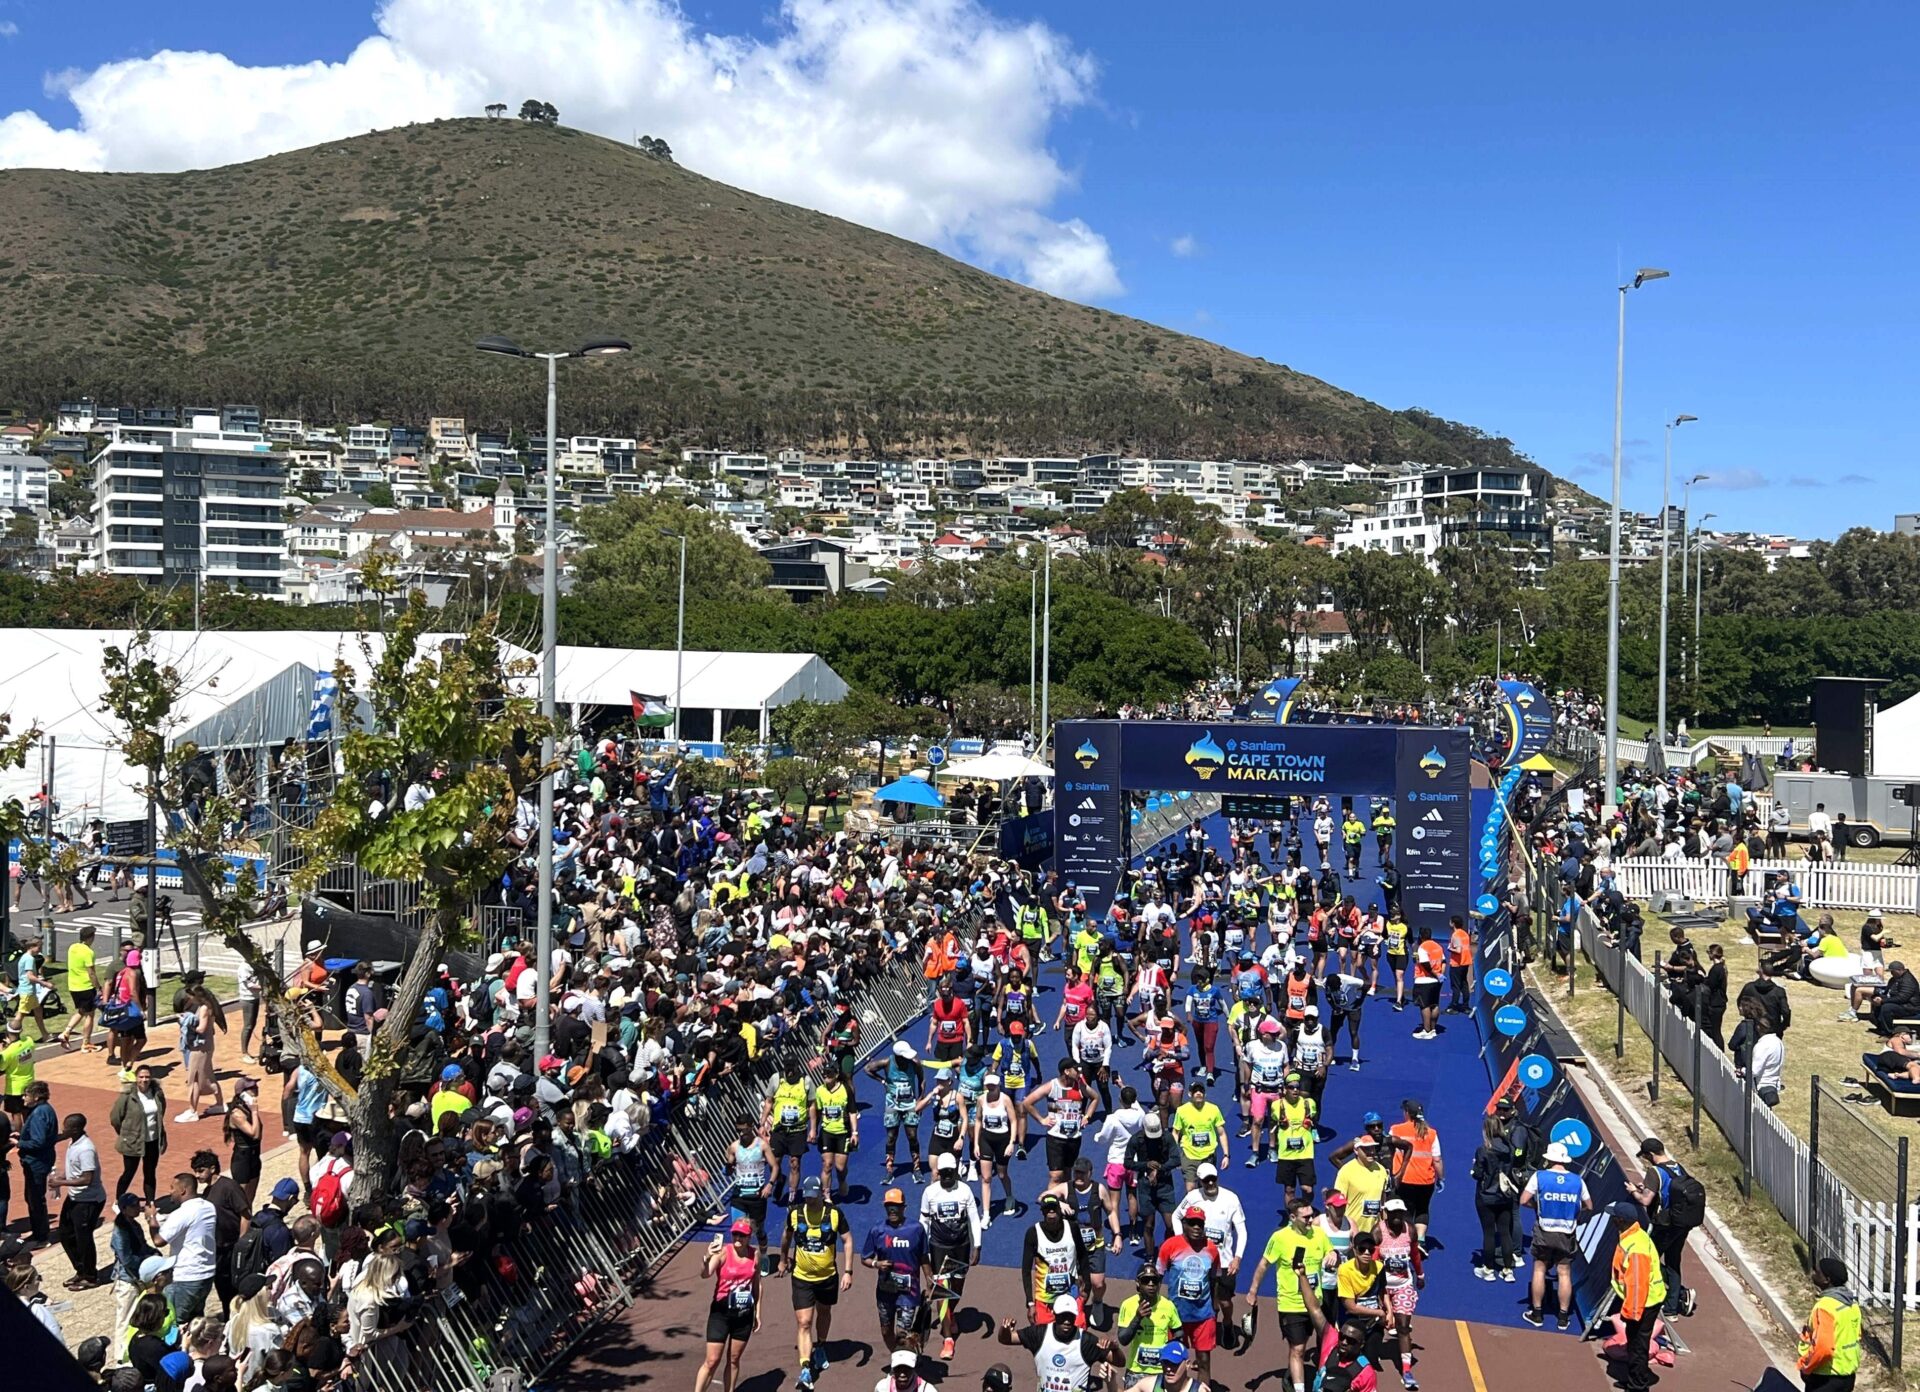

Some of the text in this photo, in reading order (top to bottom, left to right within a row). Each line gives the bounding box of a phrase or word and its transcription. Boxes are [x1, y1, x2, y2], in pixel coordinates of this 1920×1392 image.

[1240, 740, 1286, 751] Sanlam
[1228, 753, 1326, 768] CAPE TOWN
[1228, 767, 1325, 782] MARATHON
[1075, 782, 1110, 791] Sanlam
[1420, 792, 1458, 801] Sanlam
[1543, 1192, 1577, 1203] CREW
[884, 1235, 910, 1248] kfm
